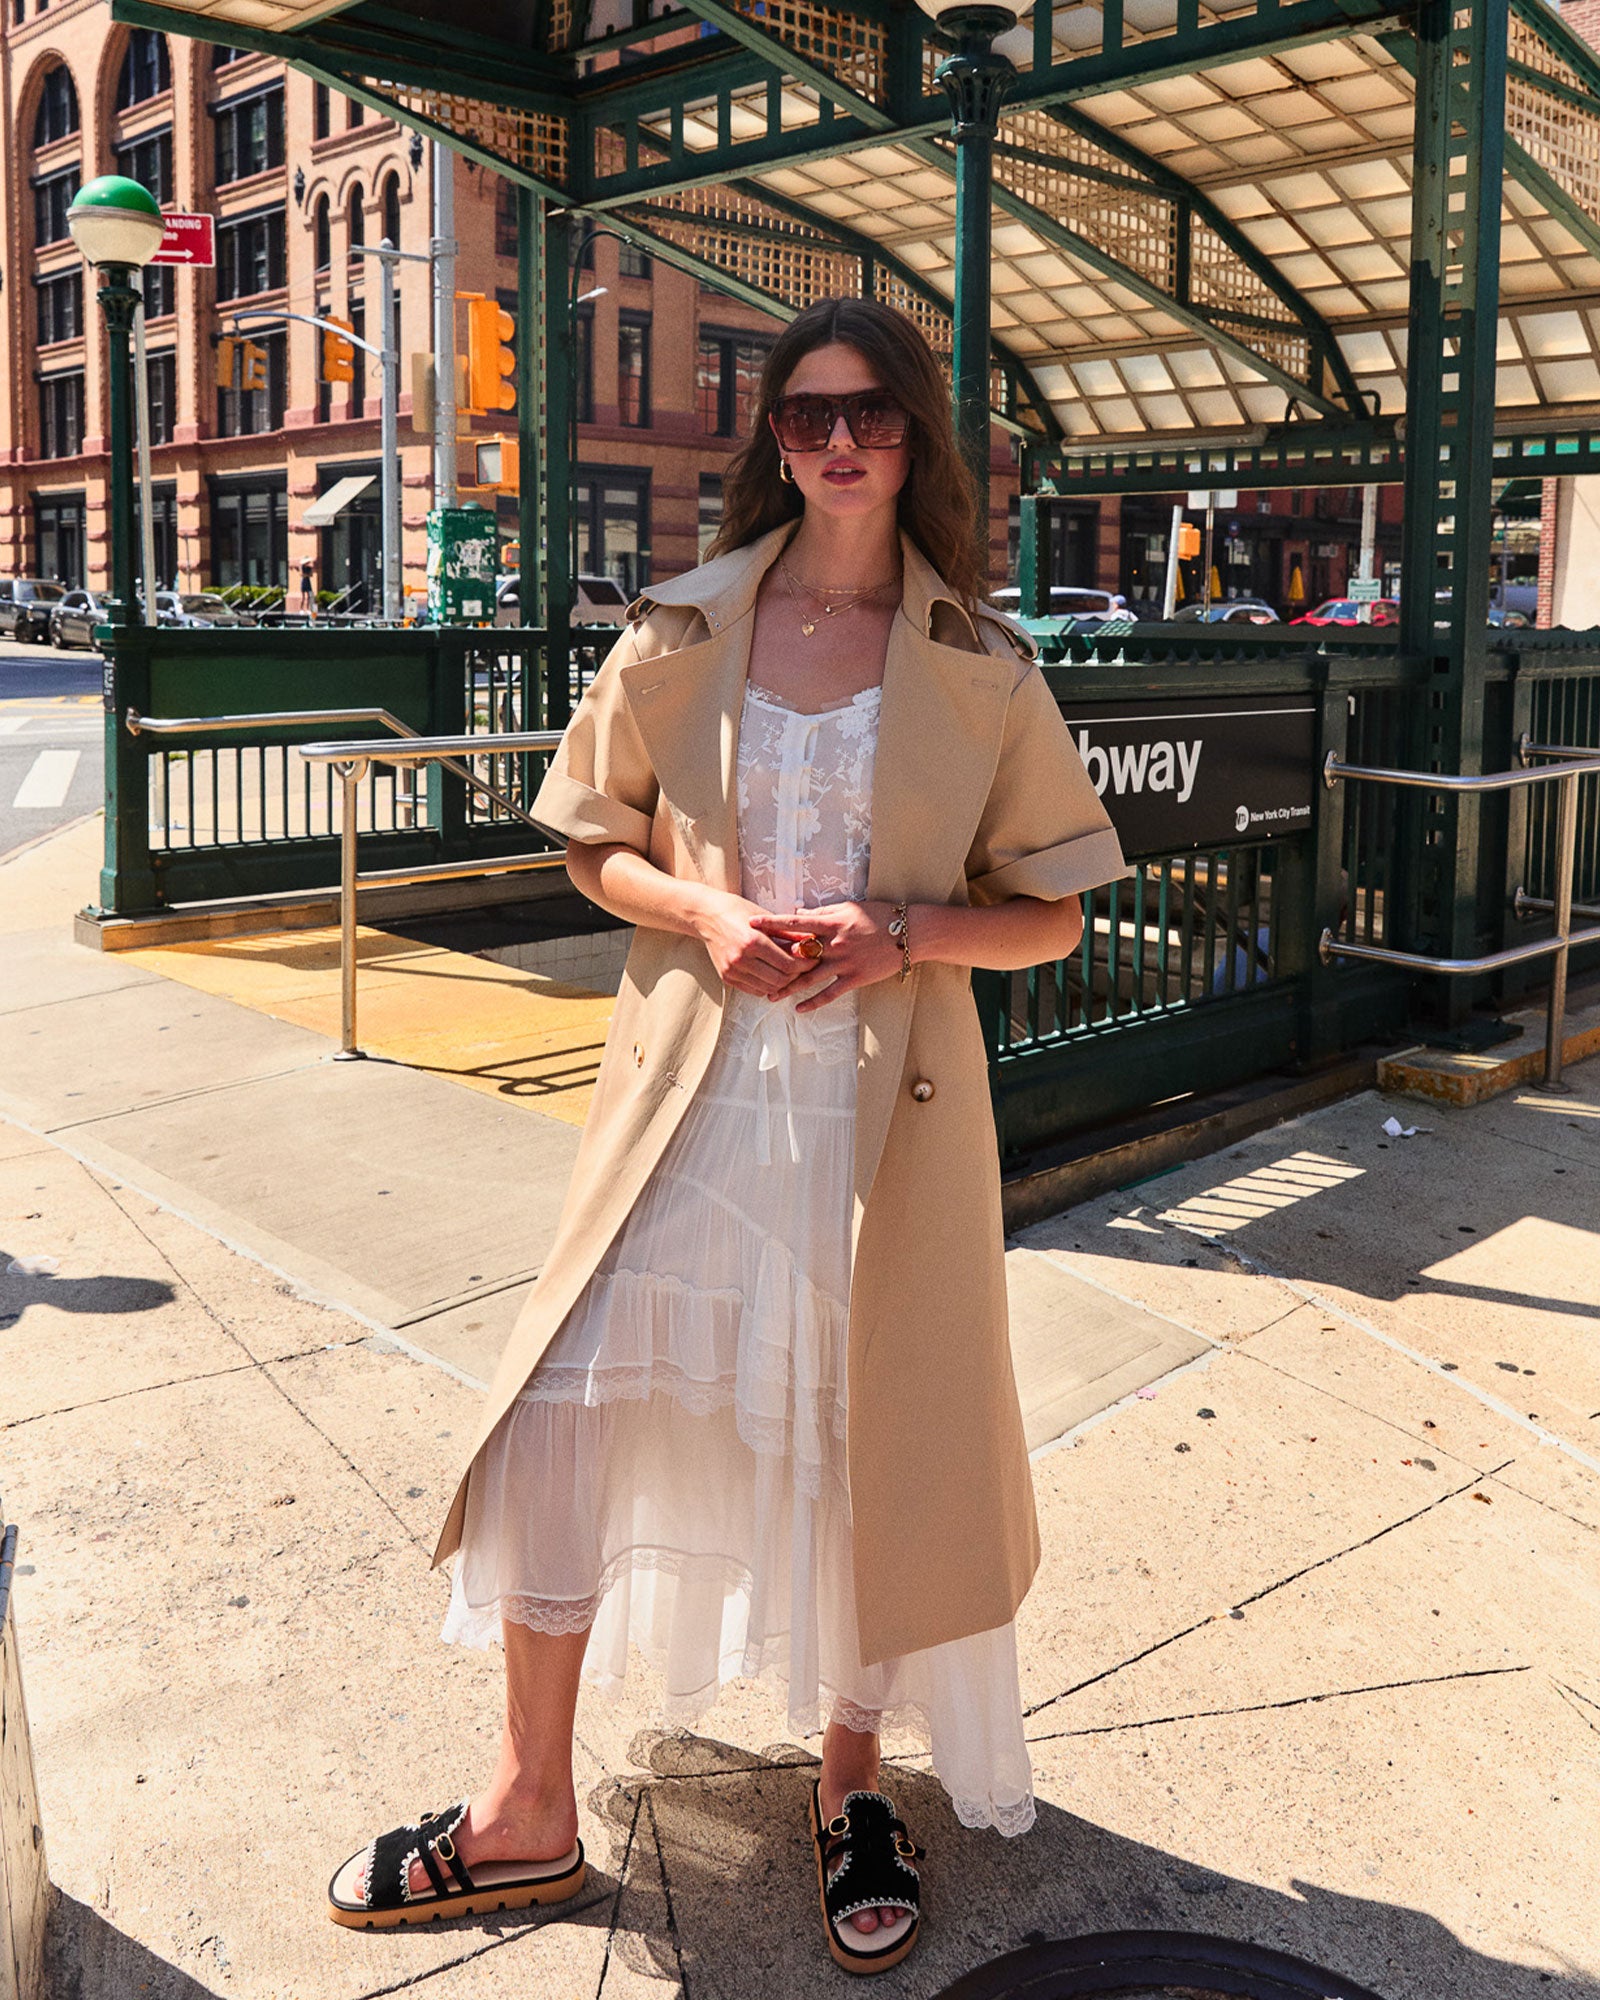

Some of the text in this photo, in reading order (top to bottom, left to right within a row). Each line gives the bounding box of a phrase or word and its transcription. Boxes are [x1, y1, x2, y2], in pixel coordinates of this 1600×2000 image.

[165, 218, 202, 230] ANDING
[1079, 730, 1203, 803] bway
[1250, 811, 1264, 822] New
[1264, 809, 1278, 820] York
[1278, 807, 1290, 820] City
[1290, 805, 1311, 817] Transit
